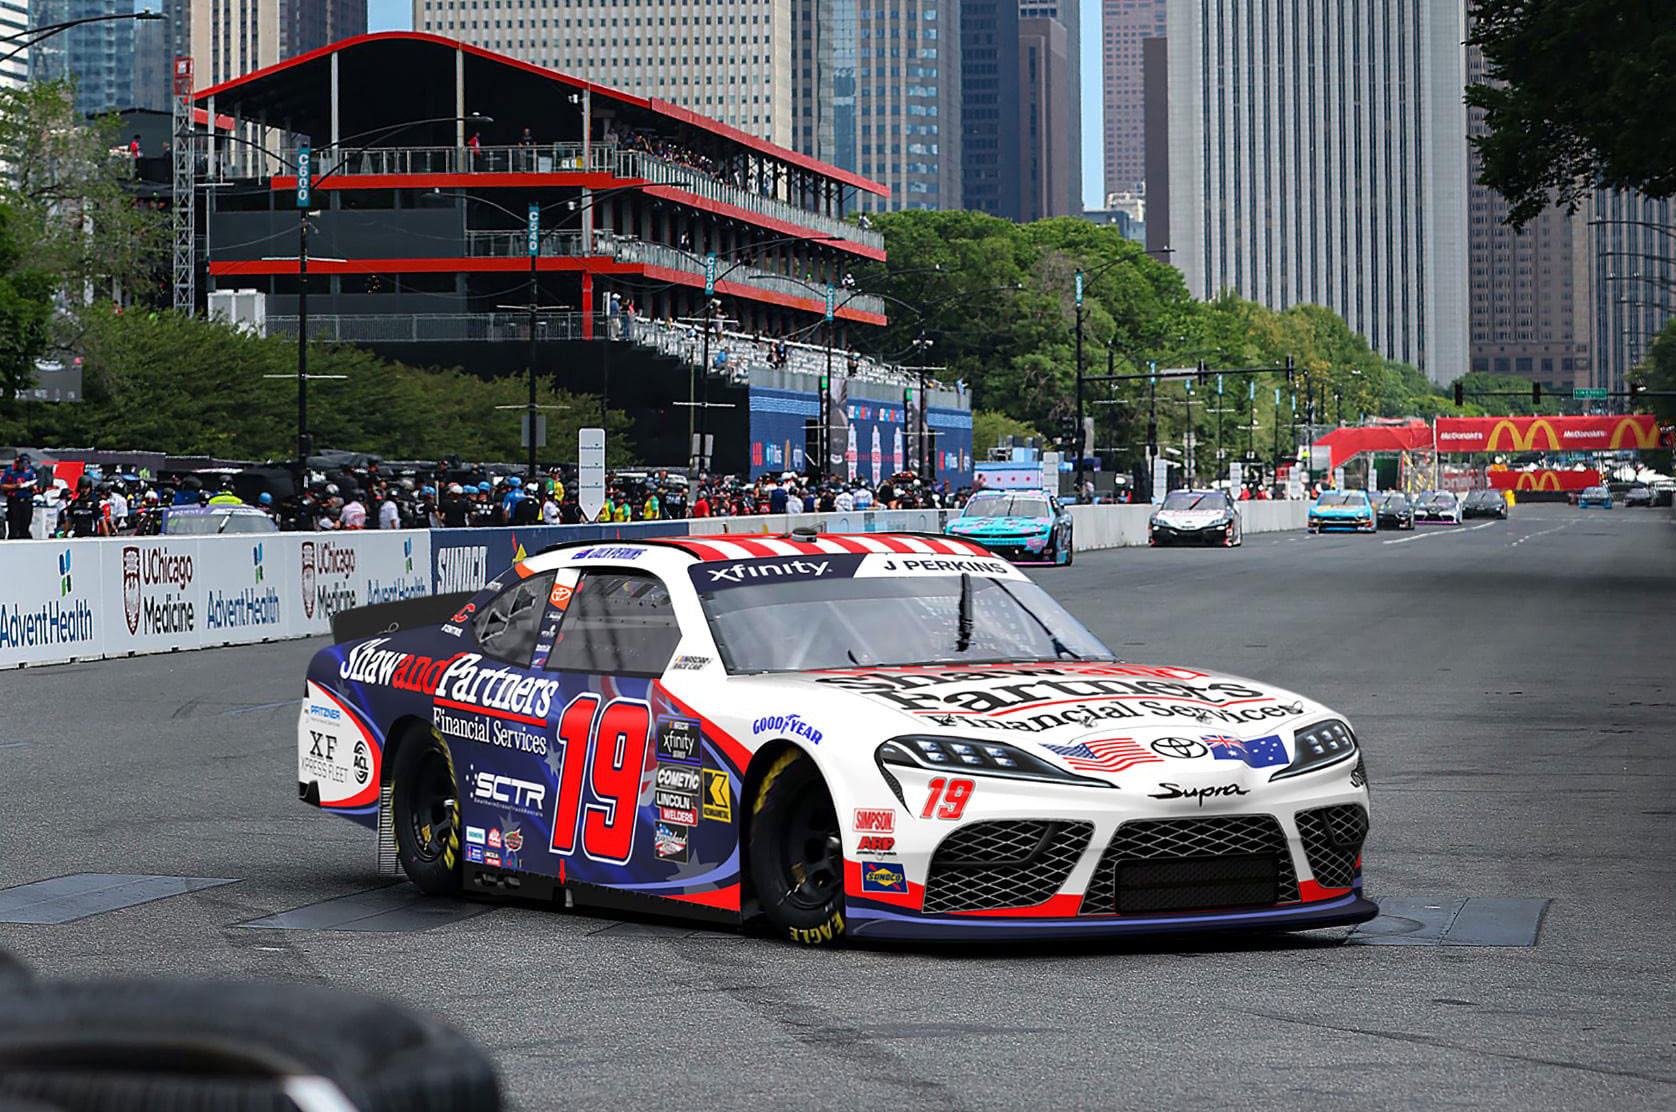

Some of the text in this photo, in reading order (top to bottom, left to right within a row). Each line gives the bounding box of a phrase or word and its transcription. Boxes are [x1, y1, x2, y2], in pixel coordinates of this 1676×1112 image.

[142, 547, 194, 590] UChicago
[317, 541, 356, 578] UChicago
[437, 546, 488, 594] SUNOCO
[707, 559, 1008, 583] xfinity J PERKINS
[0, 599, 93, 649] AdventHealth
[144, 596, 195, 636] Medicine
[207, 586, 280, 630] AdventHealth
[860, 679, 1264, 713] Partners
[432, 707, 547, 756] Financial Services
[753, 714, 823, 745] GOODYEAR
[920, 701, 1136, 733] Financial
[663, 730, 695, 756] xfinity
[475, 772, 546, 810] SCTR
[549, 691, 652, 866] 19
[657, 769, 700, 790] COMETIC
[1148, 782, 1251, 808] Supra
[656, 792, 691, 809] LINCOLN
[920, 776, 976, 821] 19
[663, 808, 695, 824] WELDERS
[855, 811, 893, 830] SIMPSON
[857, 836, 895, 850] ARP
[789, 911, 845, 944] EAGLE
